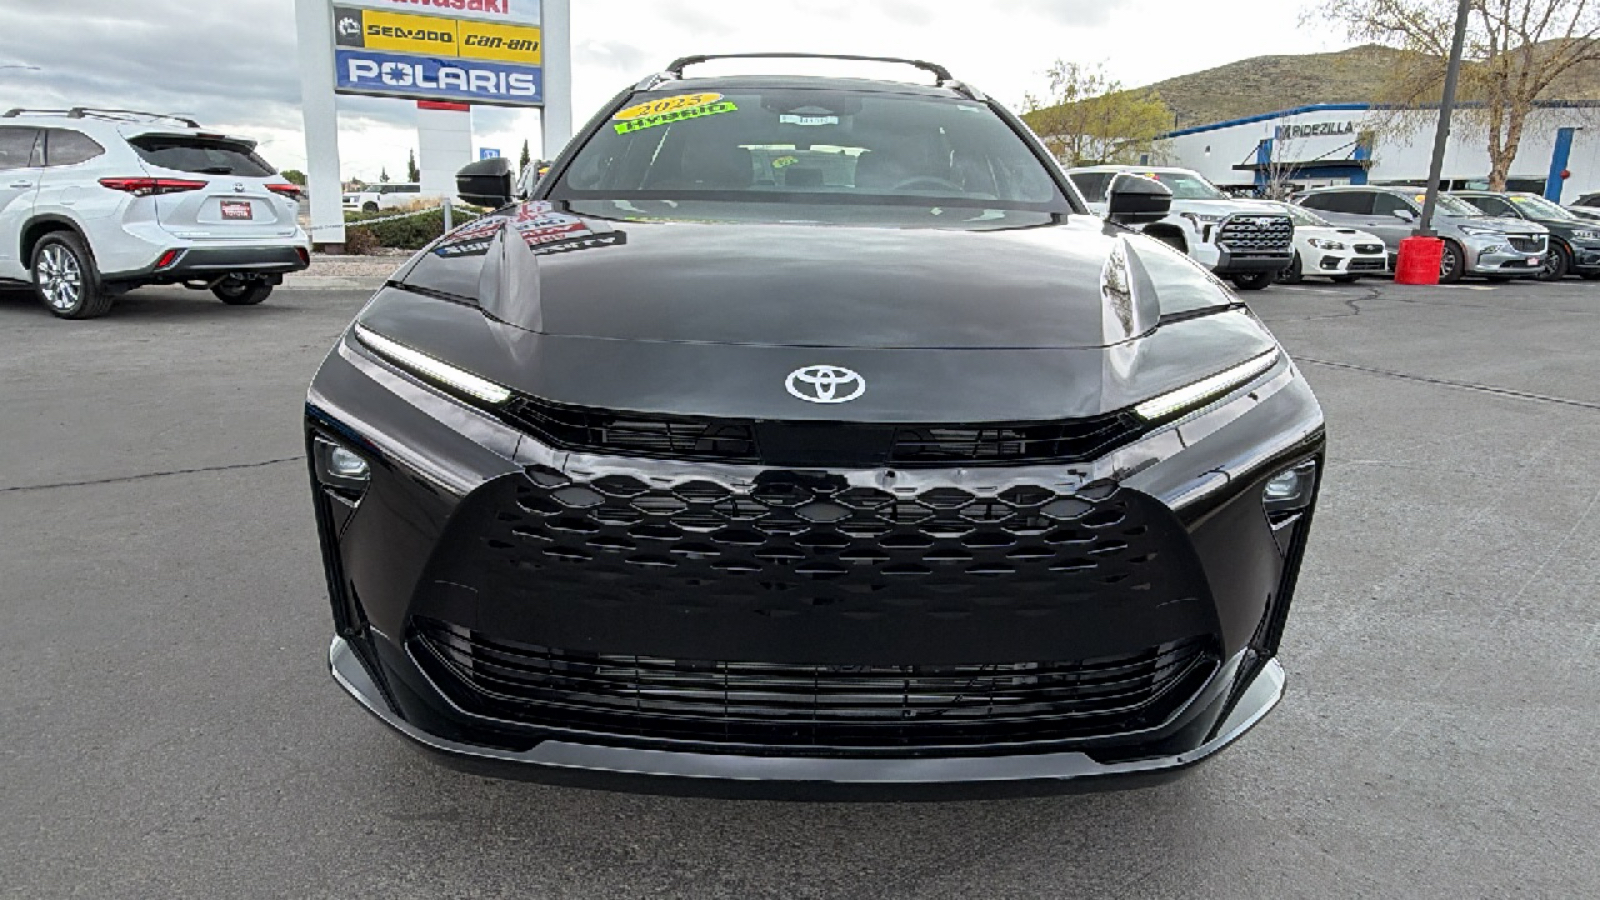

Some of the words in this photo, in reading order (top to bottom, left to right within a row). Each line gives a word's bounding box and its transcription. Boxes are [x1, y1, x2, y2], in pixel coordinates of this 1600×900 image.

[348, 59, 536, 96] POLARIS
[625, 102, 727, 131] HYBRID
[637, 94, 703, 115] 2025
[1292, 120, 1353, 137] RIDEZILLA
